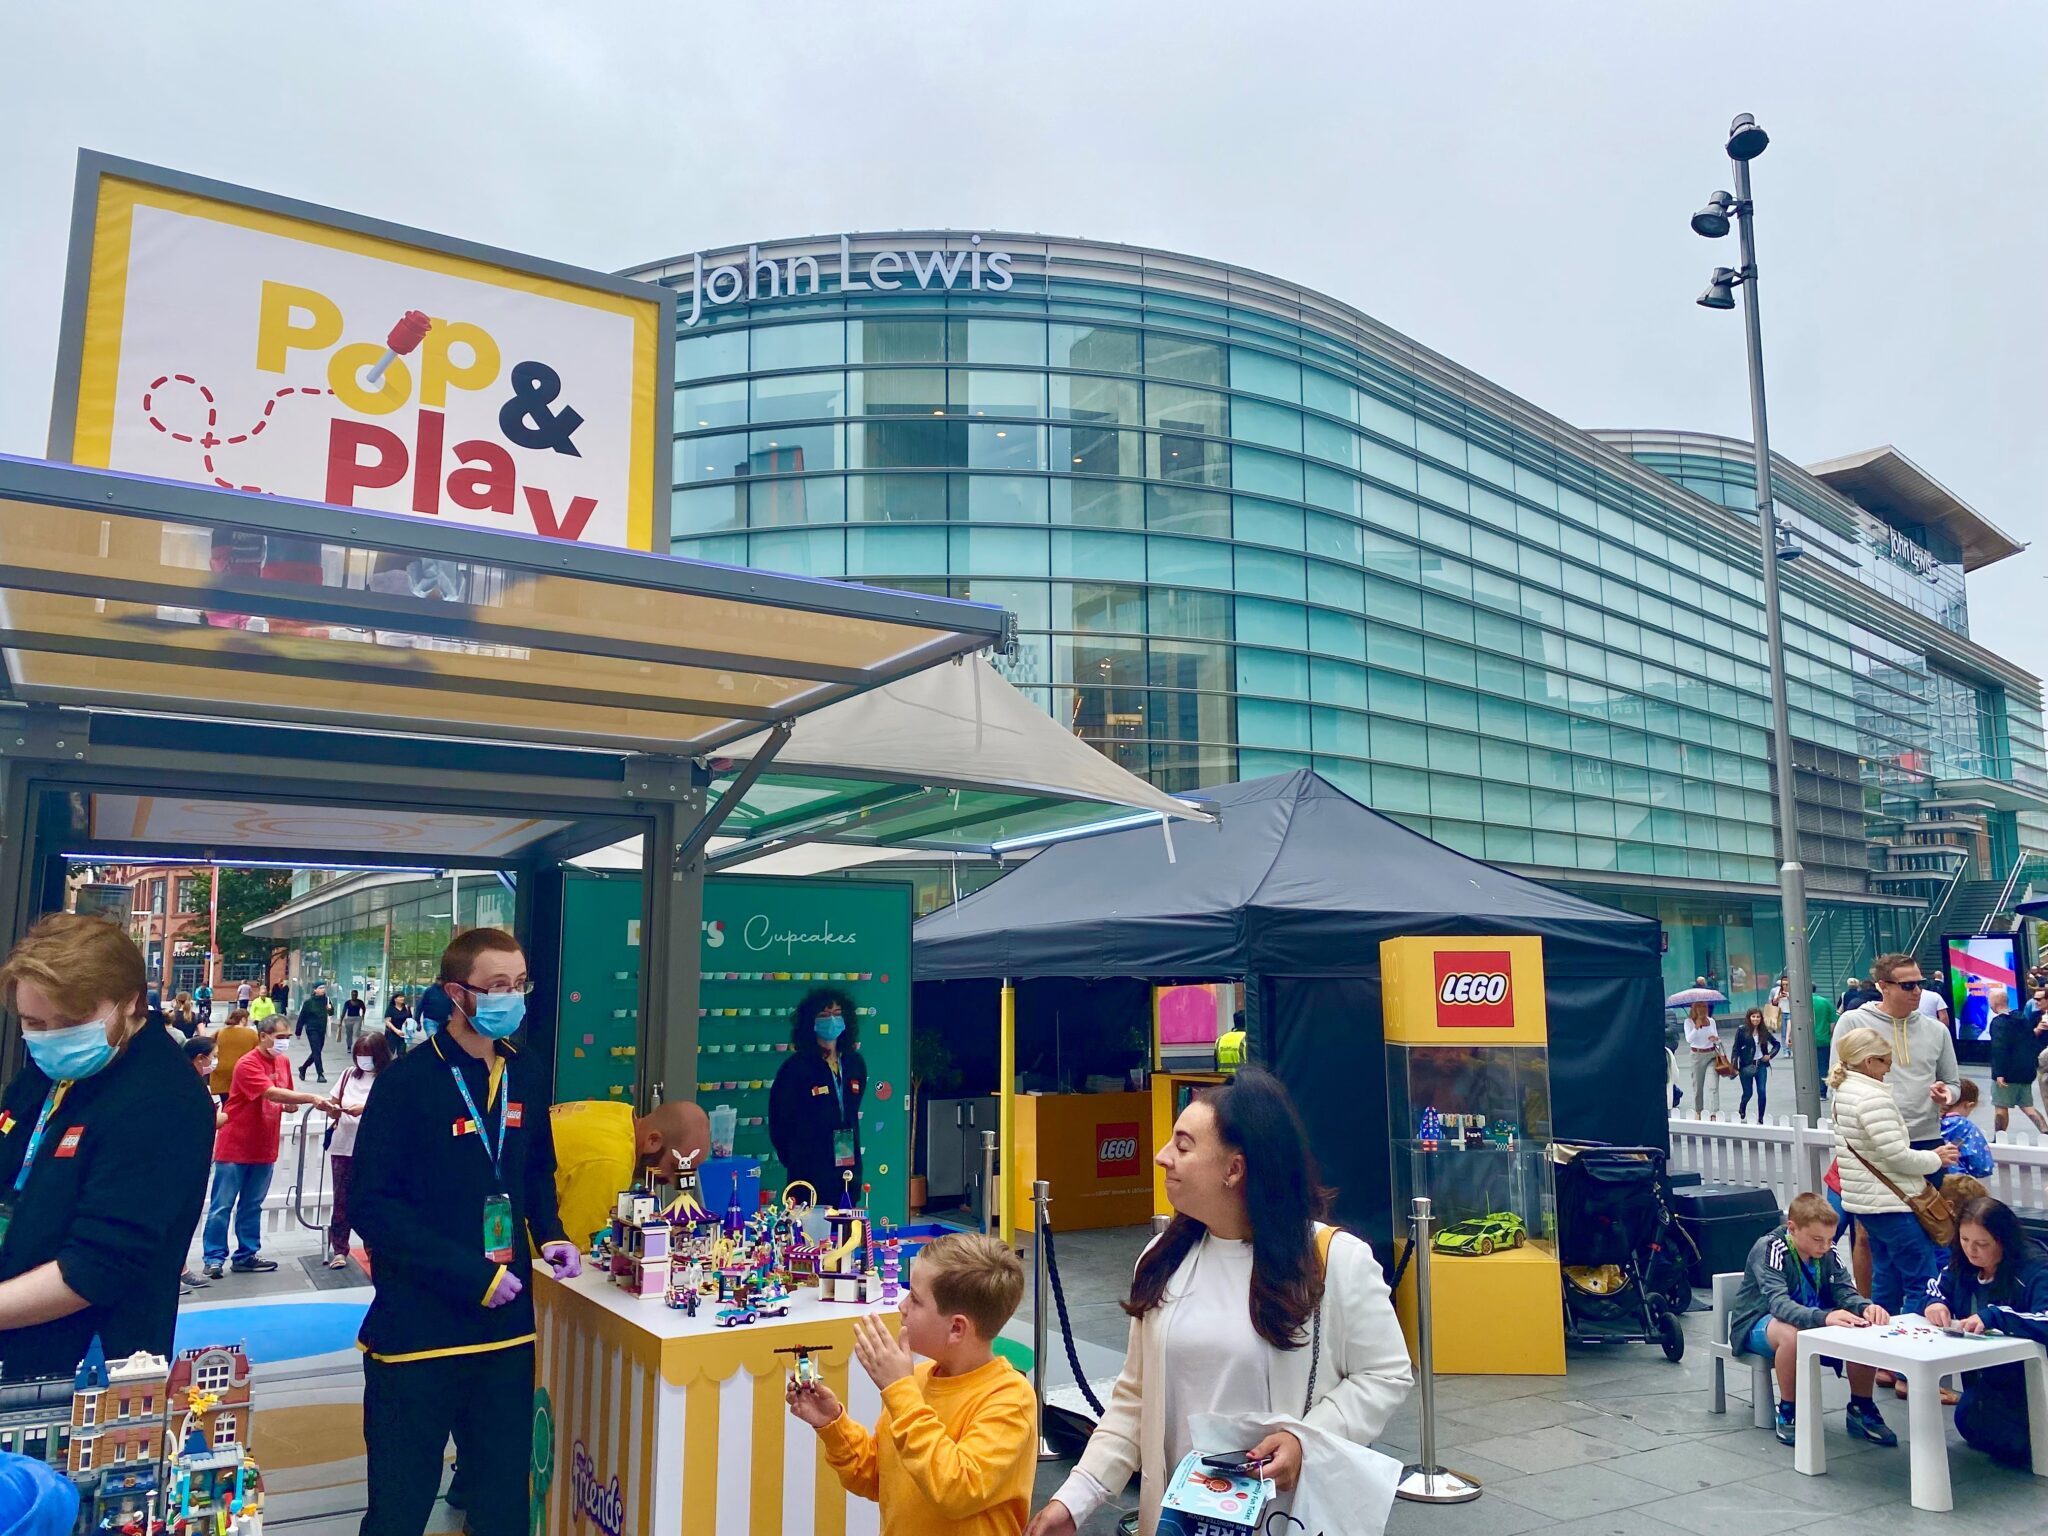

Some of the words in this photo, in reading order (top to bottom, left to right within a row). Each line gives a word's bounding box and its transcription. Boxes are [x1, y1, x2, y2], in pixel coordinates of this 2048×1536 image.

[684, 245, 819, 327] John
[840, 234, 1013, 292] Lewis
[256, 280, 500, 416] Pop
[498, 360, 585, 458] &
[744, 914, 857, 956] Cupcakes
[1440, 973, 1508, 1005] LEGO
[1099, 1138, 1137, 1161] LEGO
